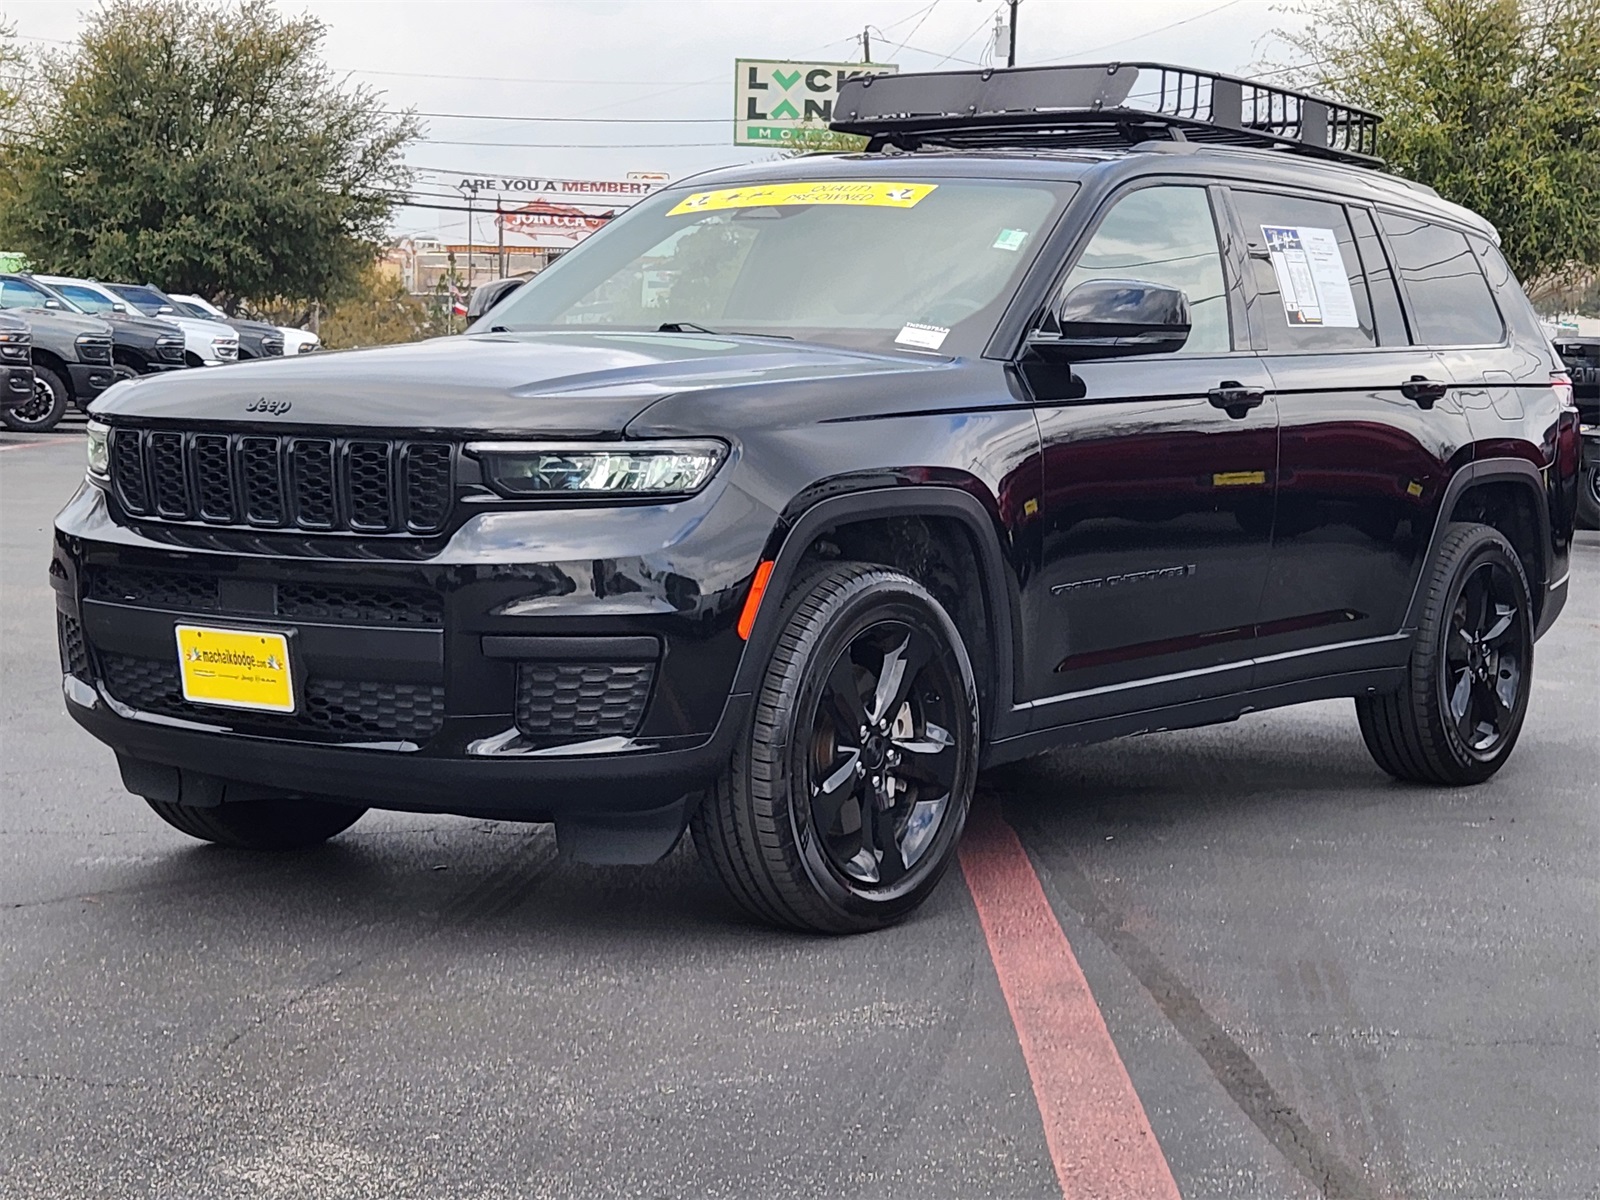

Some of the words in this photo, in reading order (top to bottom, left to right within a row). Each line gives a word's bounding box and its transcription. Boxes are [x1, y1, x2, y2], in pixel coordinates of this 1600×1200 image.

[747, 97, 832, 122] LAN
[459, 179, 496, 190] ARE
[501, 180, 539, 191] YOU
[543, 181, 557, 192] A
[561, 182, 651, 194] MEMBER?
[512, 213, 550, 225] JOIN
[553, 214, 586, 227] CCA
[245, 396, 293, 417] Jeep
